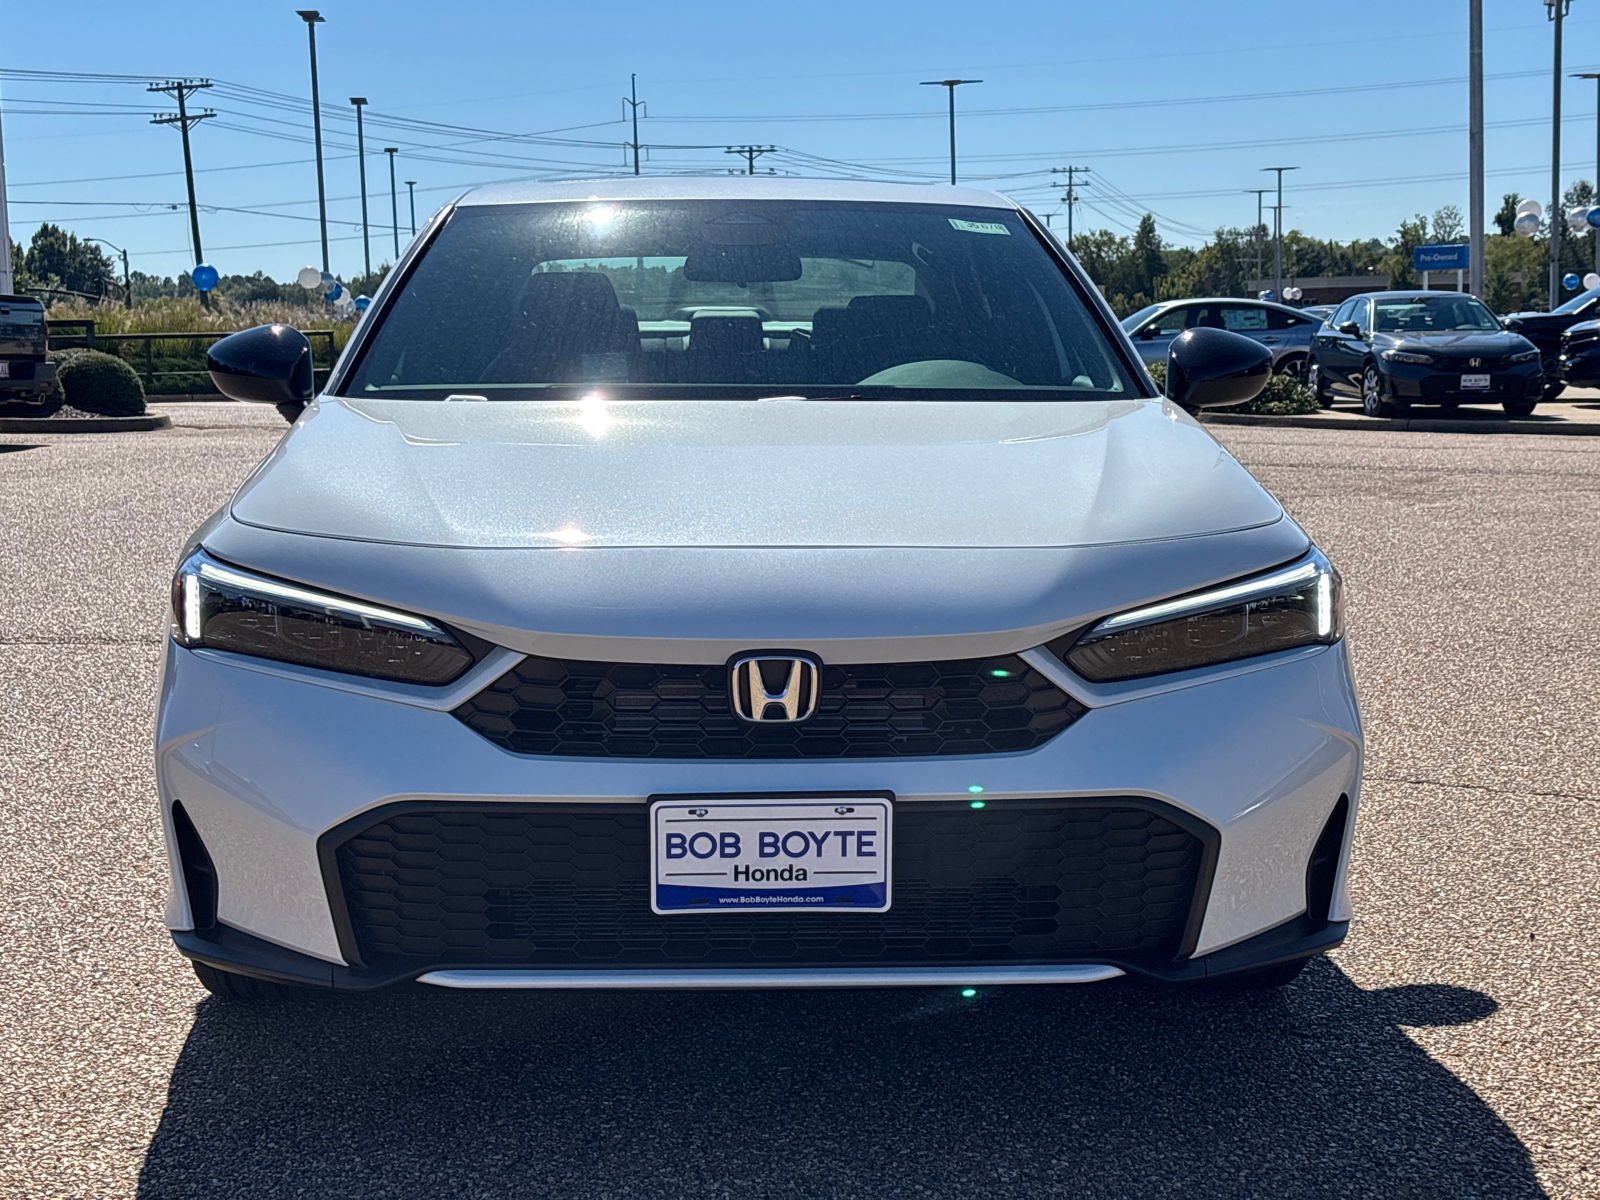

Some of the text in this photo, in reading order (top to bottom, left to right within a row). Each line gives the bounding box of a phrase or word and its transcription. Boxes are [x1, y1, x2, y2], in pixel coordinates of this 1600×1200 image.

[1420, 252, 1458, 261] Pre-Owned
[665, 830, 877, 859] BOB BOYTE
[733, 864, 808, 882] Honda
[719, 895, 824, 904] www.BobBoyteHonda.com
